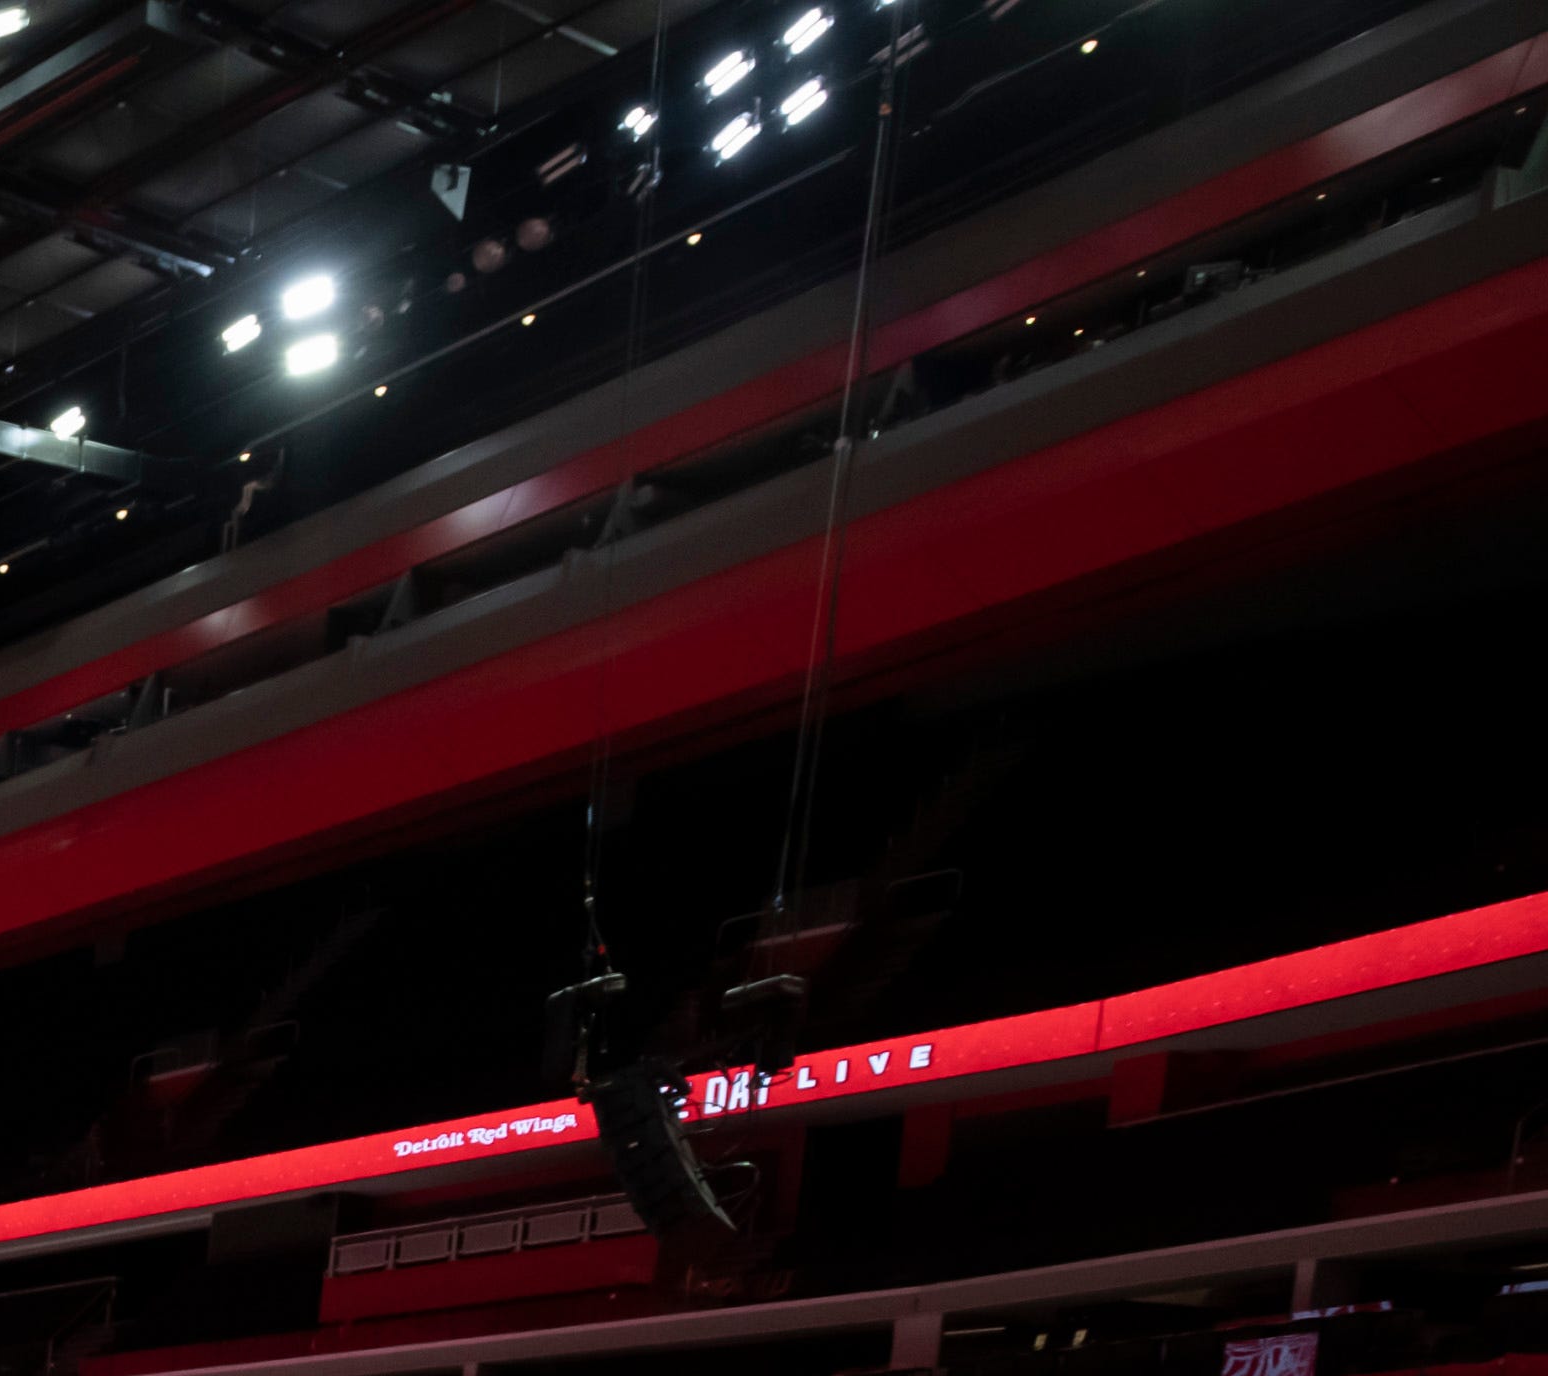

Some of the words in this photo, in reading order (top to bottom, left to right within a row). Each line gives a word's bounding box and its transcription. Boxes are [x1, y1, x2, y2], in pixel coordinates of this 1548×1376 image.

[393, 1130, 464, 1157] Detroit
[467, 1123, 508, 1146] Red
[509, 1112, 577, 1139] Wings
[796, 1044, 932, 1090] LIVE
